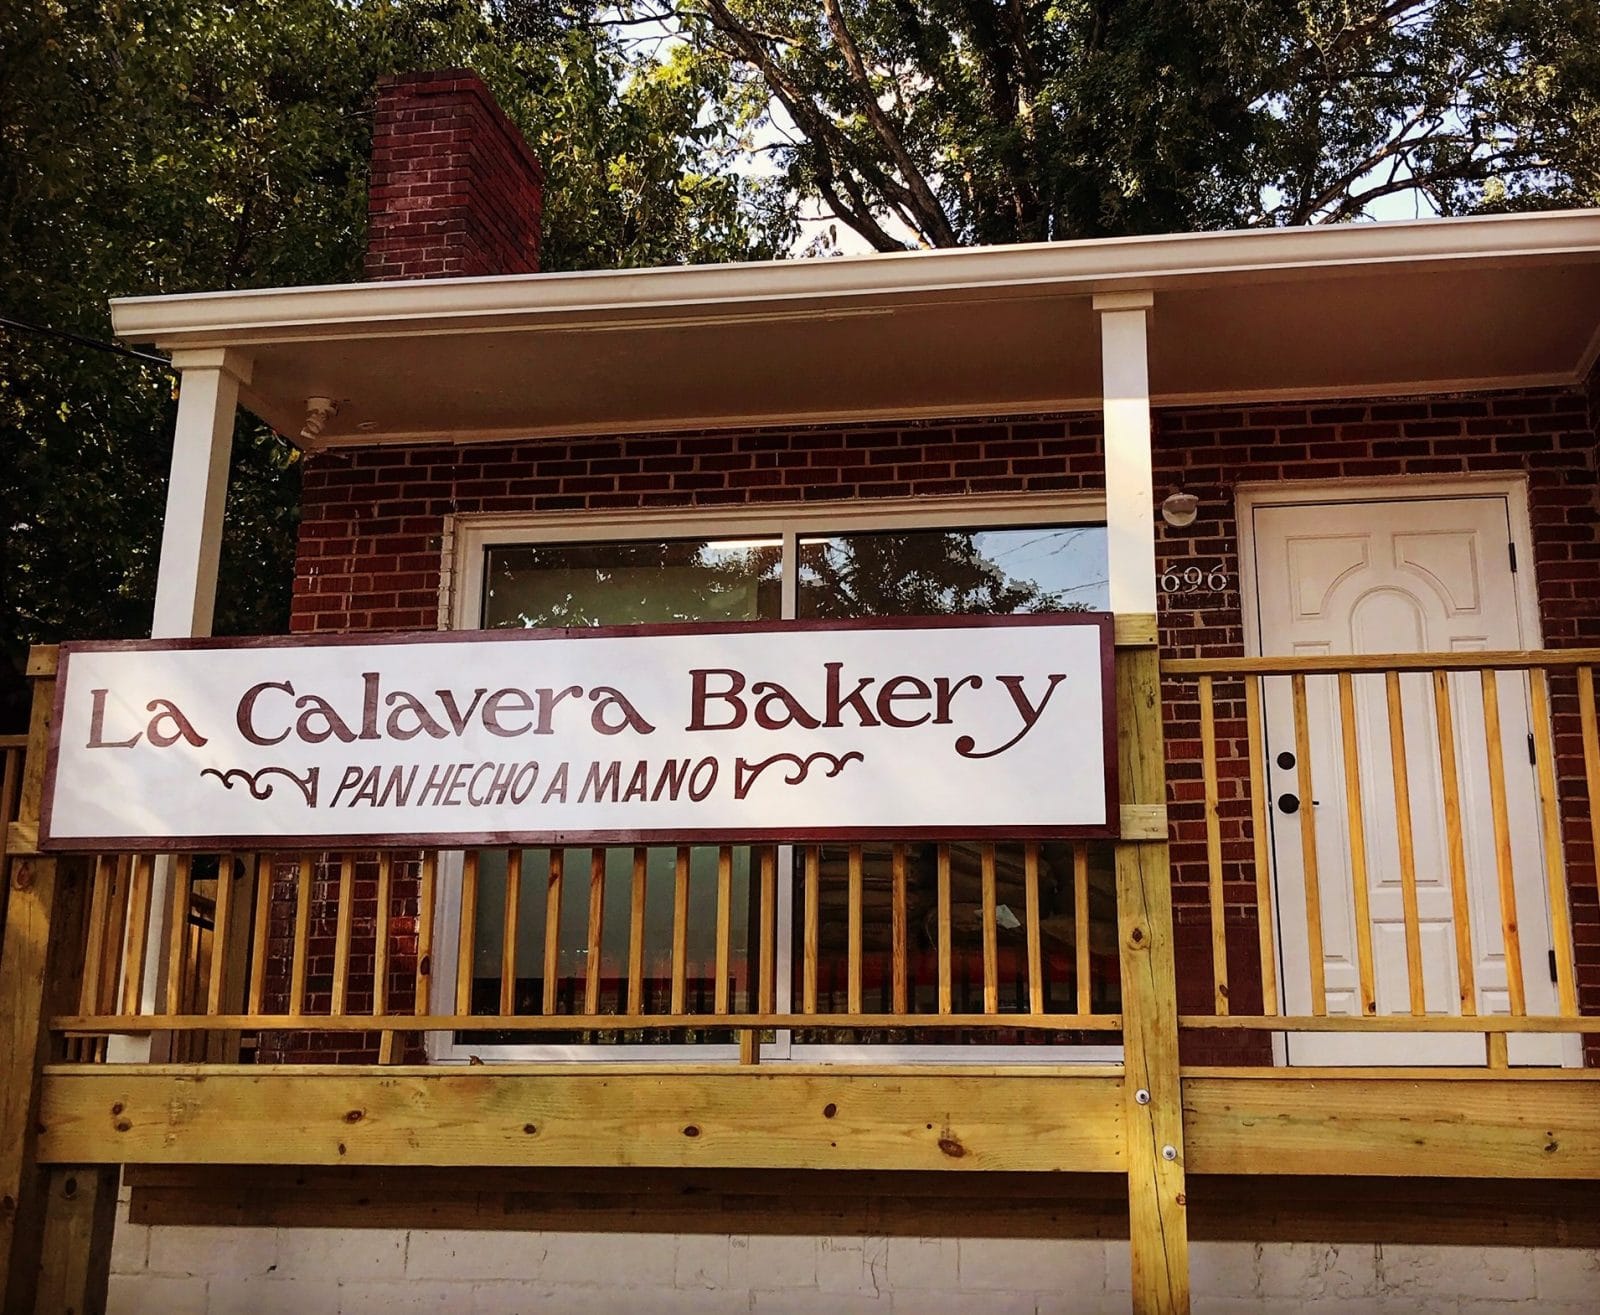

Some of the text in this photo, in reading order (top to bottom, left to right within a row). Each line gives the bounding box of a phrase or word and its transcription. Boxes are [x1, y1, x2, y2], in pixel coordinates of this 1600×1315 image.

[1161, 565, 1227, 593] 696
[86, 661, 1067, 759] La Calavera Bakery
[330, 756, 719, 808] PAN HECHO A MANO
